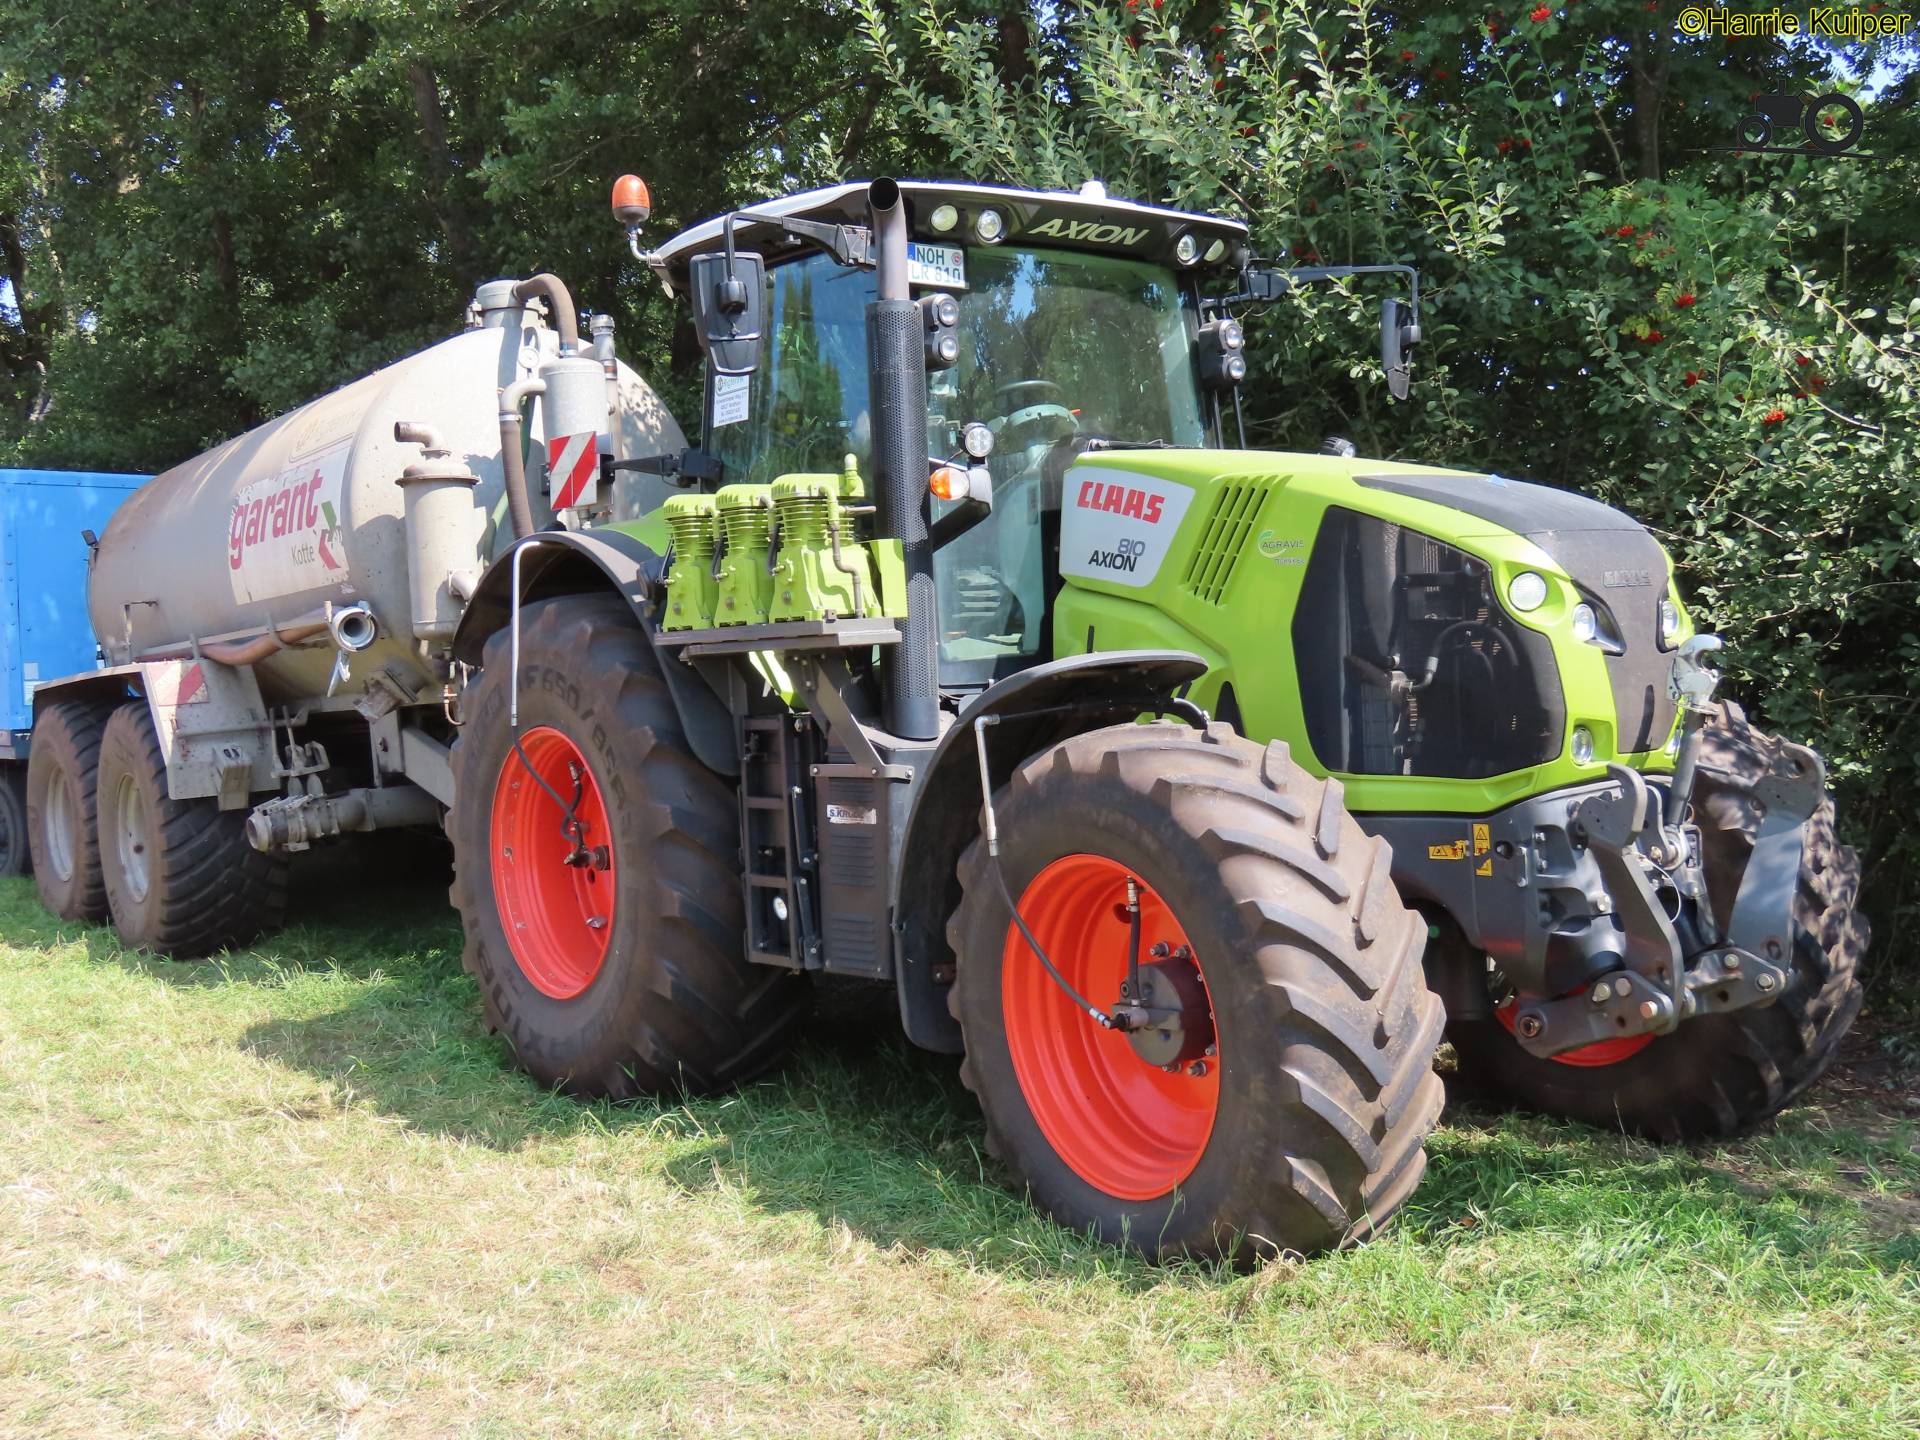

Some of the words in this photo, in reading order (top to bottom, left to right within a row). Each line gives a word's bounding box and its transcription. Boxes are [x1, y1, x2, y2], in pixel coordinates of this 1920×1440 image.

[1027, 218, 1150, 245] AXION
[917, 247, 944, 265] NOH
[1077, 481, 1165, 524] CLAAS
[230, 468, 324, 571] garant
[291, 541, 316, 565] Kotte
[1117, 538, 1146, 557] 810
[1088, 550, 1138, 573] AXION
